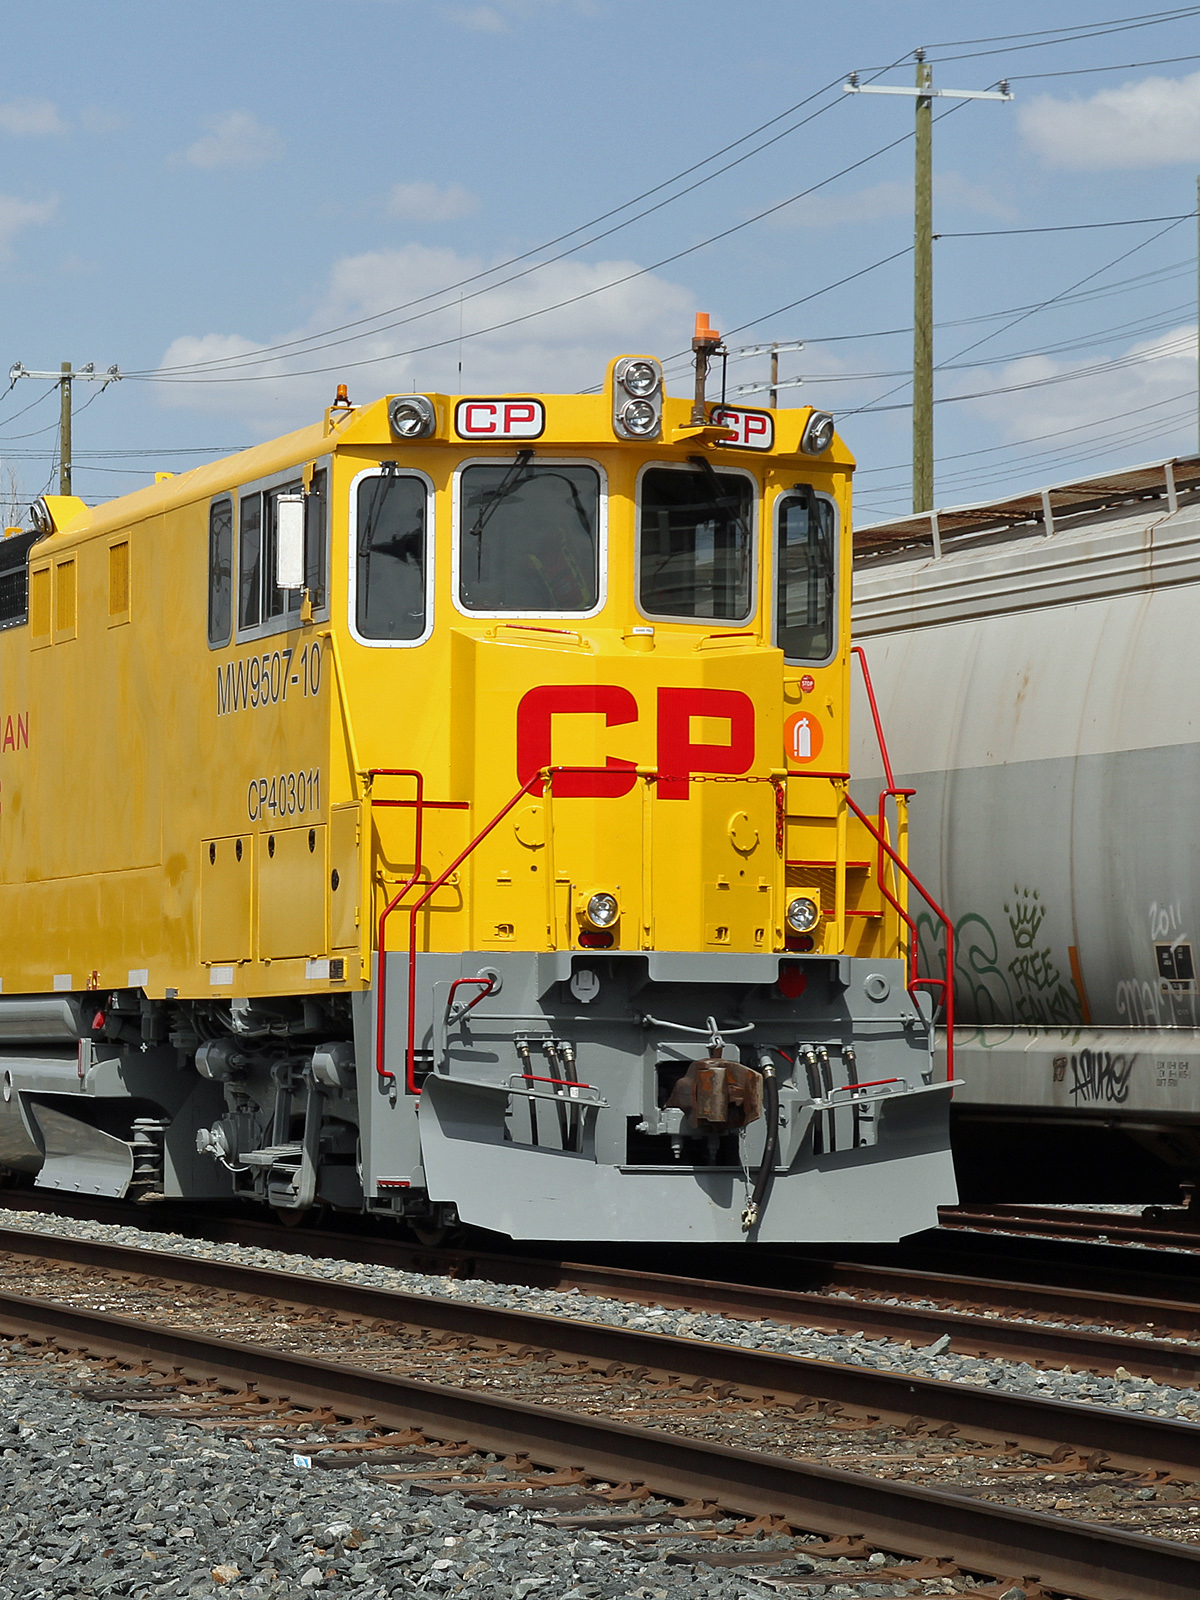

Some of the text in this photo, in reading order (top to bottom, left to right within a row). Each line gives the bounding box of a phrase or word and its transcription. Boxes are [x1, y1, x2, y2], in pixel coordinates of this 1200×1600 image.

[465, 404, 535, 433] CP
[717, 412, 767, 443] CP
[216, 641, 322, 717] MW9507-10
[516, 684, 755, 801] CP
[247, 766, 321, 822] CP403011
[1008, 948, 1060, 993] FREE
